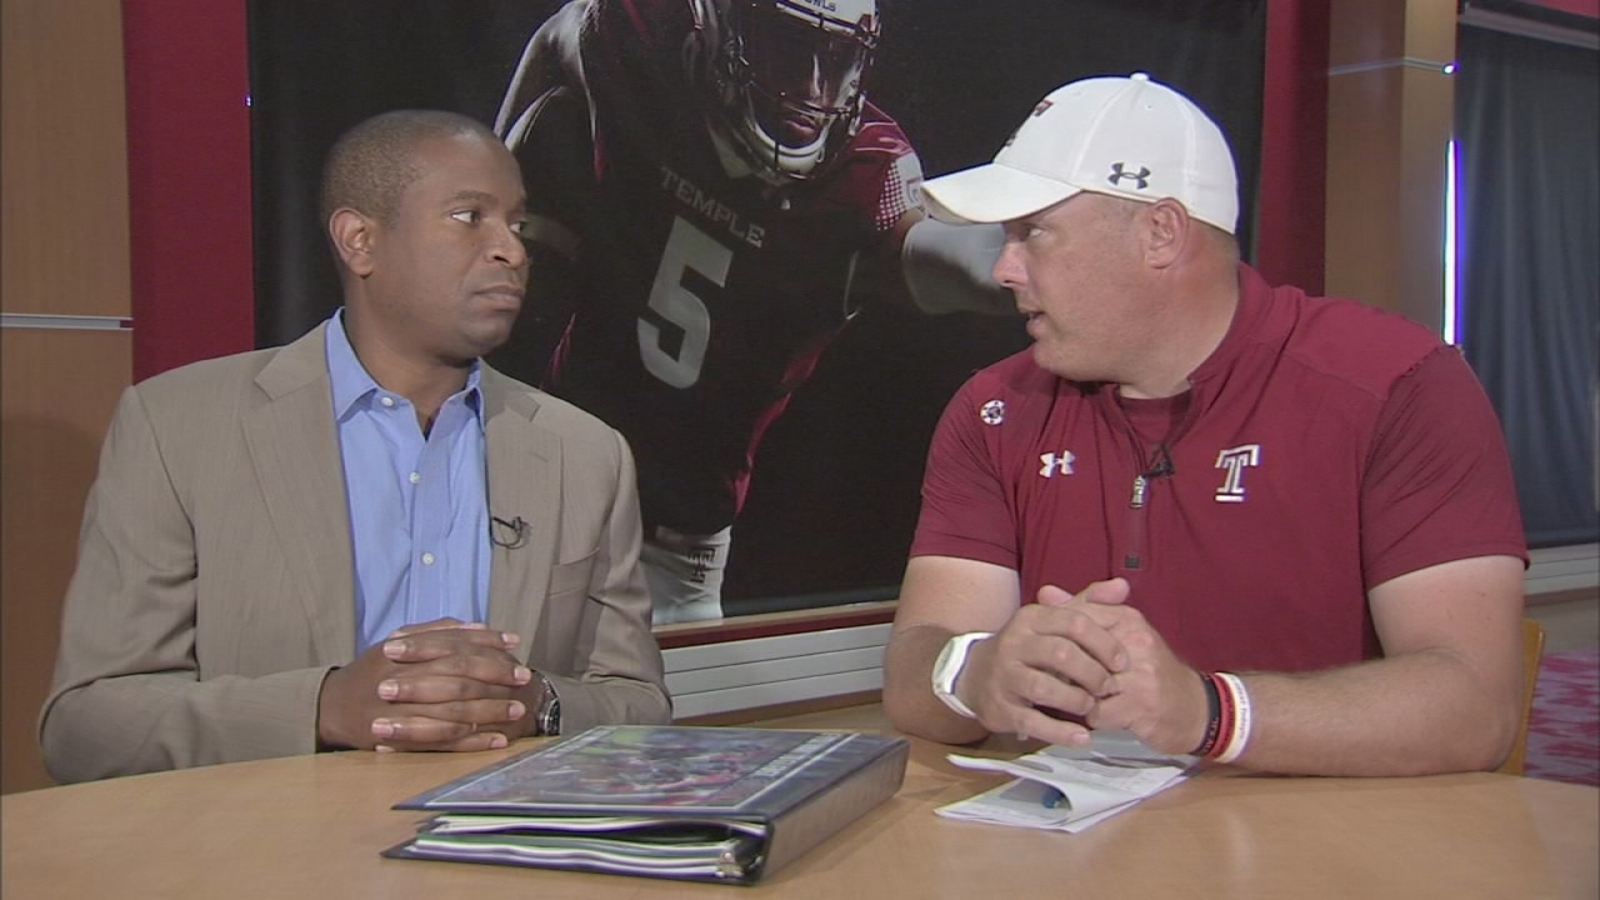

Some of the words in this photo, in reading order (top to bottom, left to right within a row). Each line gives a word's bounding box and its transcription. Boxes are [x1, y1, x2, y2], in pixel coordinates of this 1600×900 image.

[660, 166, 765, 248] TEMPLE
[637, 215, 734, 389] 5
[1214, 444, 1260, 502] T
